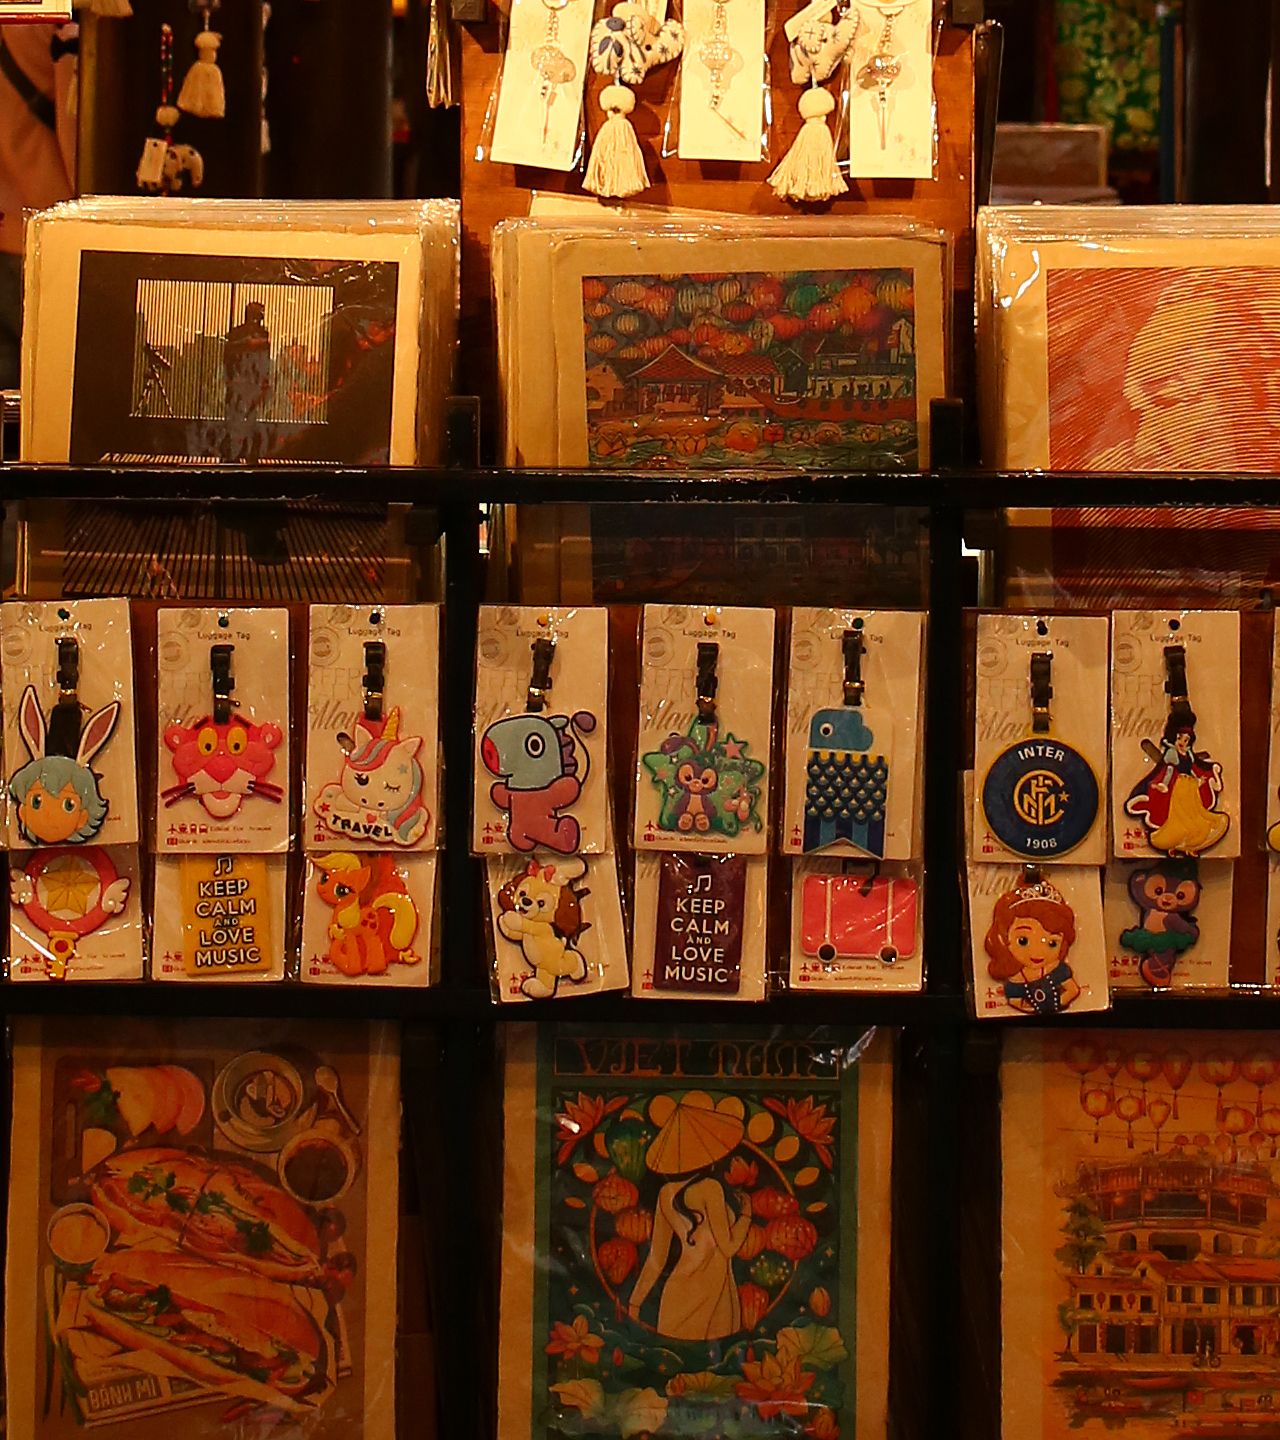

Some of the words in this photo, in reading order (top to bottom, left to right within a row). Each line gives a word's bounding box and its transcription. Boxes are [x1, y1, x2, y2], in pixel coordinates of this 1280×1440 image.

[197, 631, 235, 641] Luggage
[236, 630, 251, 640] Tag
[348, 627, 385, 637] Luggage
[682, 628, 719, 639] Luggage
[722, 629, 736, 640] Tag
[1015, 637, 1053, 648] Luggage
[1054, 637, 1070, 647] Tag
[1016, 744, 1066, 763] INTER
[330, 813, 395, 840] TRAVEL
[1024, 835, 1058, 851] 1908
[198, 880, 249, 898] KEEP
[196, 898, 257, 917] CALM
[676, 896, 726, 914] KEEP
[214, 916, 240, 927] AND
[670, 917, 730, 936] CALM
[200, 927, 254, 947] LOVE
[687, 934, 711, 945] AND
[196, 945, 262, 967] MUSIC
[671, 945, 724, 965] LOVE
[665, 963, 729, 984] MUSIC
[575, 1038, 693, 1078] VIET
[707, 1040, 821, 1079] NAM
